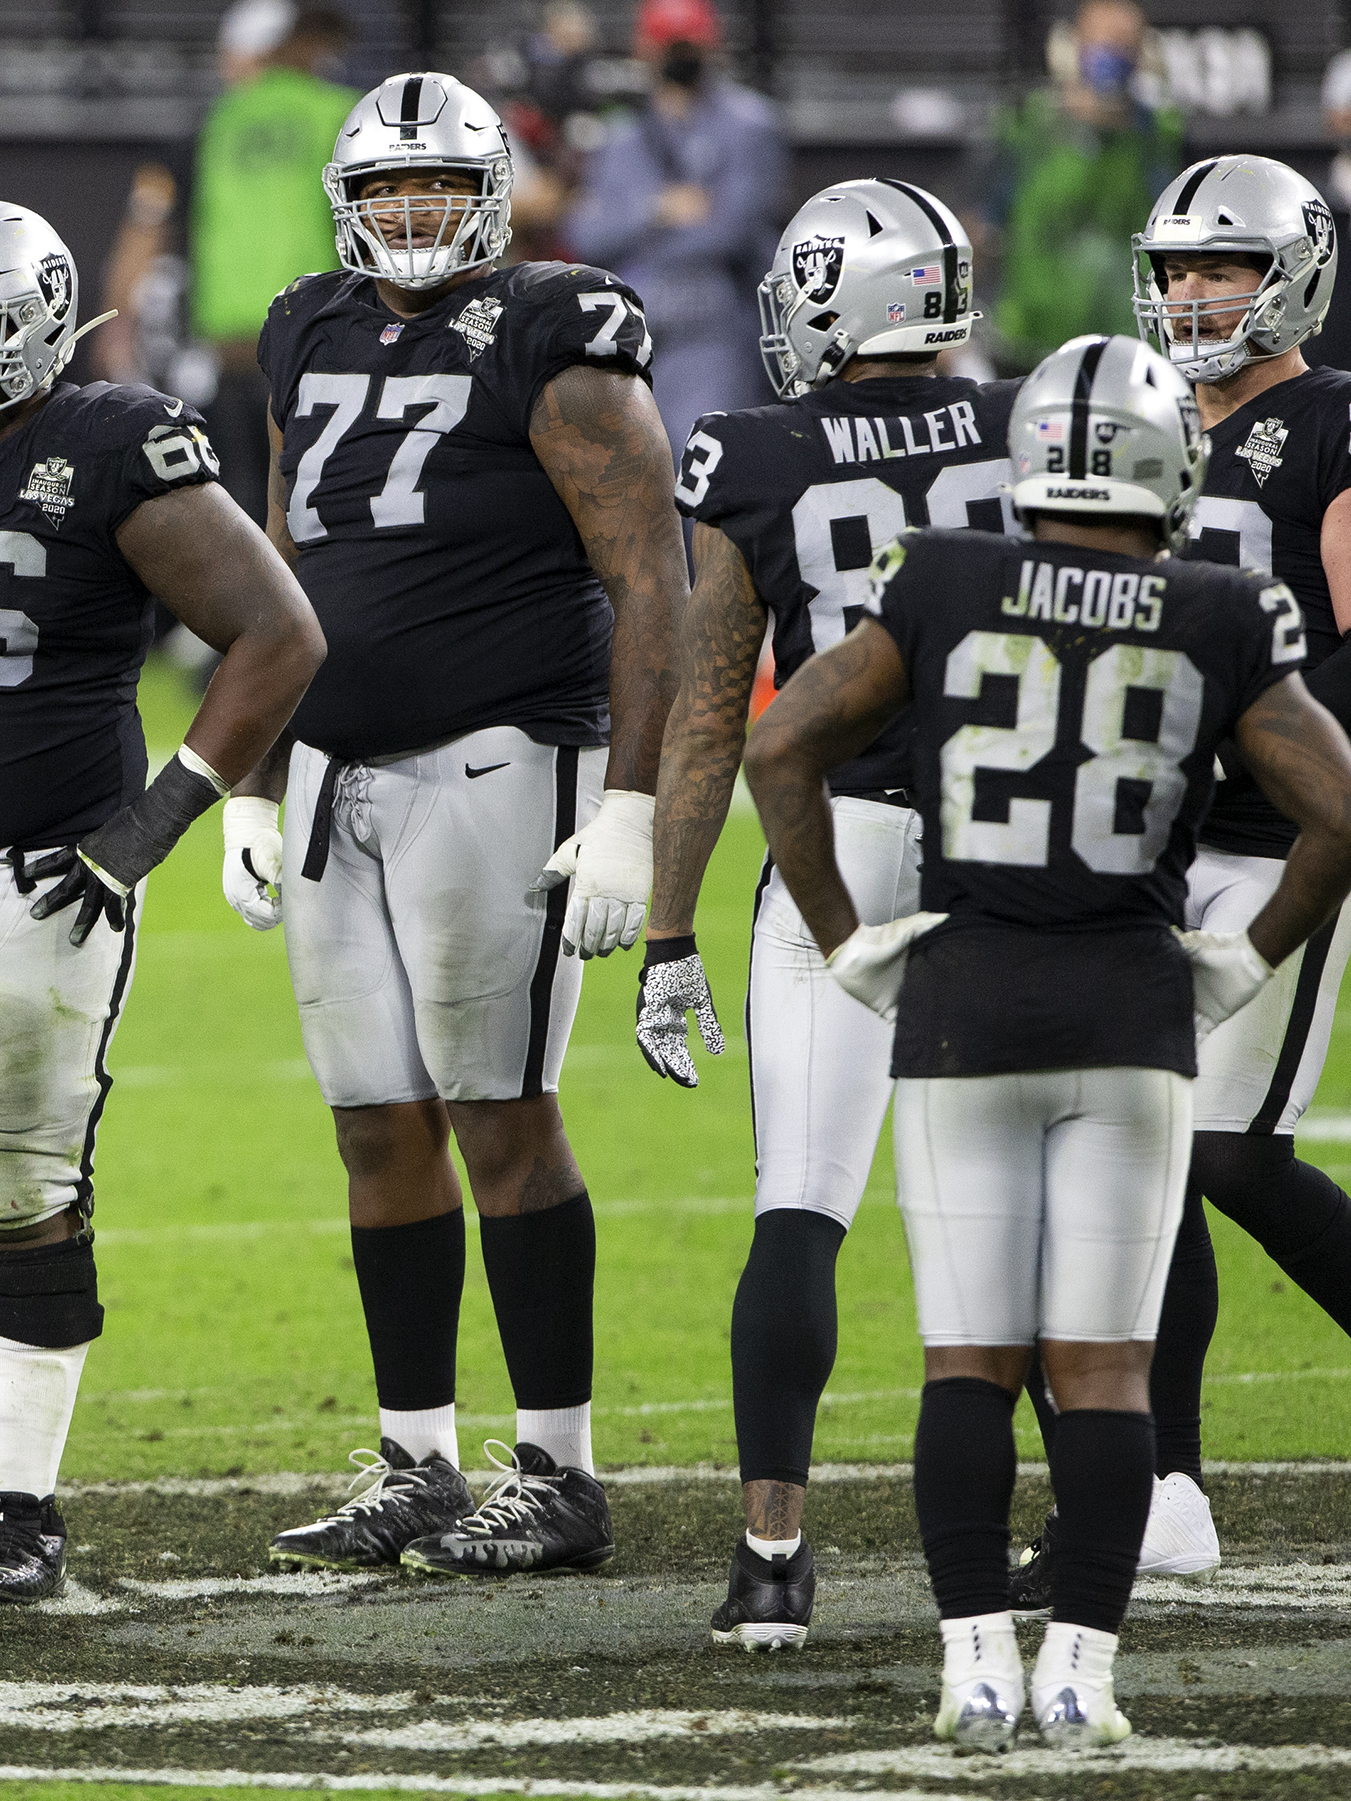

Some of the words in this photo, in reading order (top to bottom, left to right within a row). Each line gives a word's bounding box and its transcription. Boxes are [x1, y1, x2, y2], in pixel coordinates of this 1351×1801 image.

[1303, 202, 1331, 217] RAIDERS
[460, 315, 492, 333] SEASON
[888, 311, 904, 322] NFL
[924, 327, 968, 344] RAIDERS
[466, 336, 486, 351] 2020
[821, 401, 983, 465] WALLER
[1246, 441, 1277, 456] SEASON
[286, 373, 472, 543] 77
[1250, 460, 1272, 473] 2020
[30, 483, 66, 496] SEASON
[32, 479, 68, 489] INAUGURAL
[19, 488, 39, 501] LAS
[39, 490, 75, 508] VEGAS
[1046, 487, 1111, 501] RAIDERS
[41, 503, 66, 515] 2020
[1000, 559, 1167, 632] JACOBS
[940, 630, 1205, 875] 28
